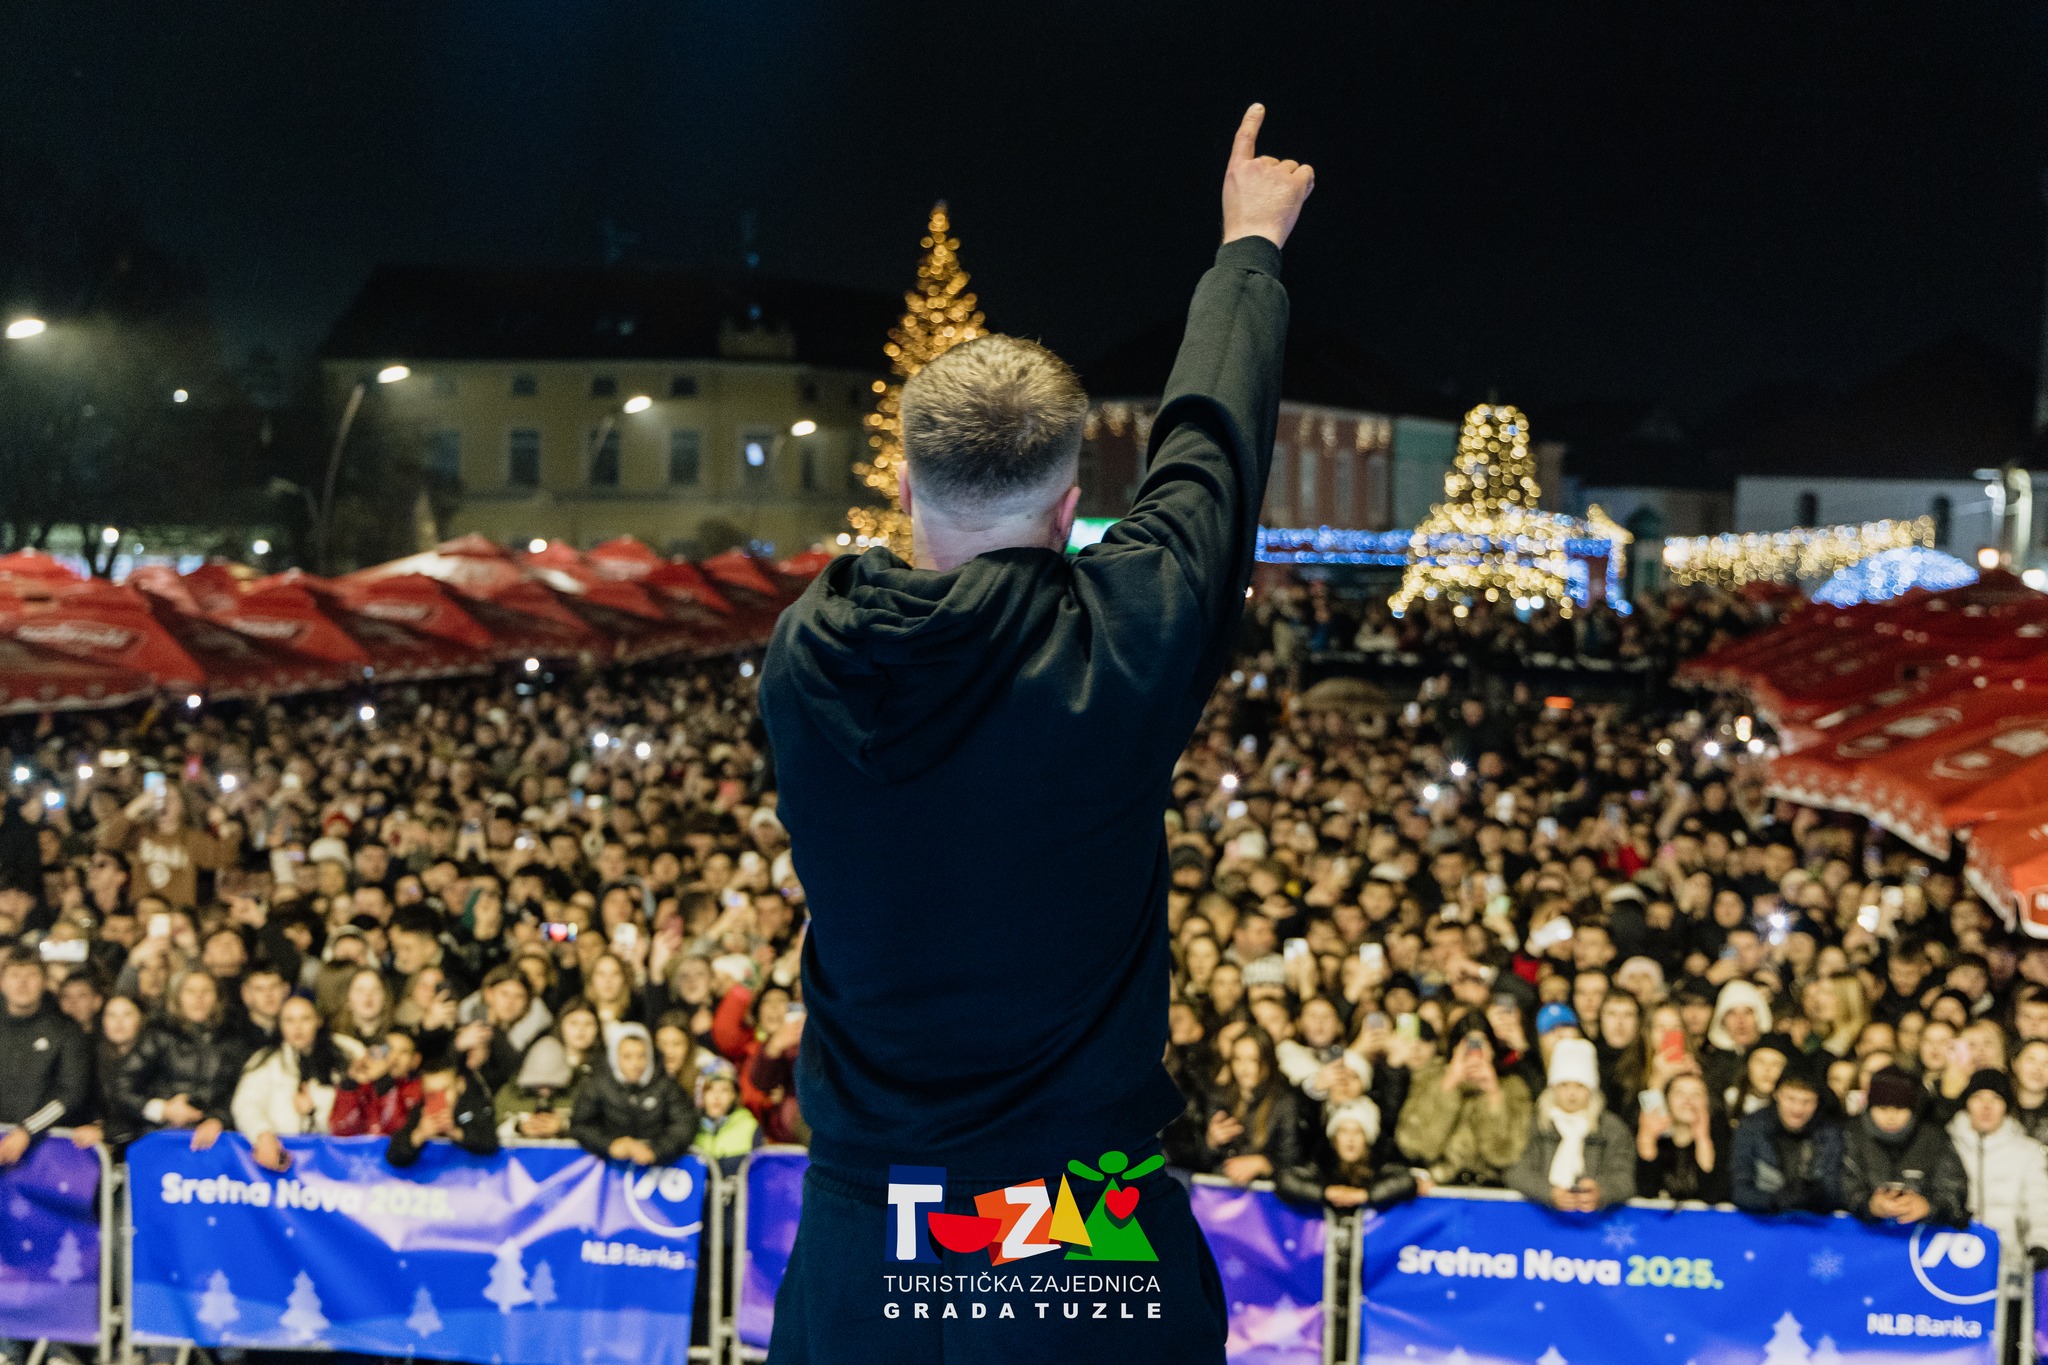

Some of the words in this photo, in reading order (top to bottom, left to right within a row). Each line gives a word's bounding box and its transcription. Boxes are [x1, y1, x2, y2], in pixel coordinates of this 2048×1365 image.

[161, 1172, 271, 1207] Sretna
[275, 1178, 363, 1213] Nova
[581, 1240, 624, 1265] NLB
[1397, 1245, 1517, 1279] Sretna
[1523, 1248, 1621, 1286] Nova
[1626, 1255, 1724, 1290] 2025.
[1867, 1312, 1914, 1336] NLB
